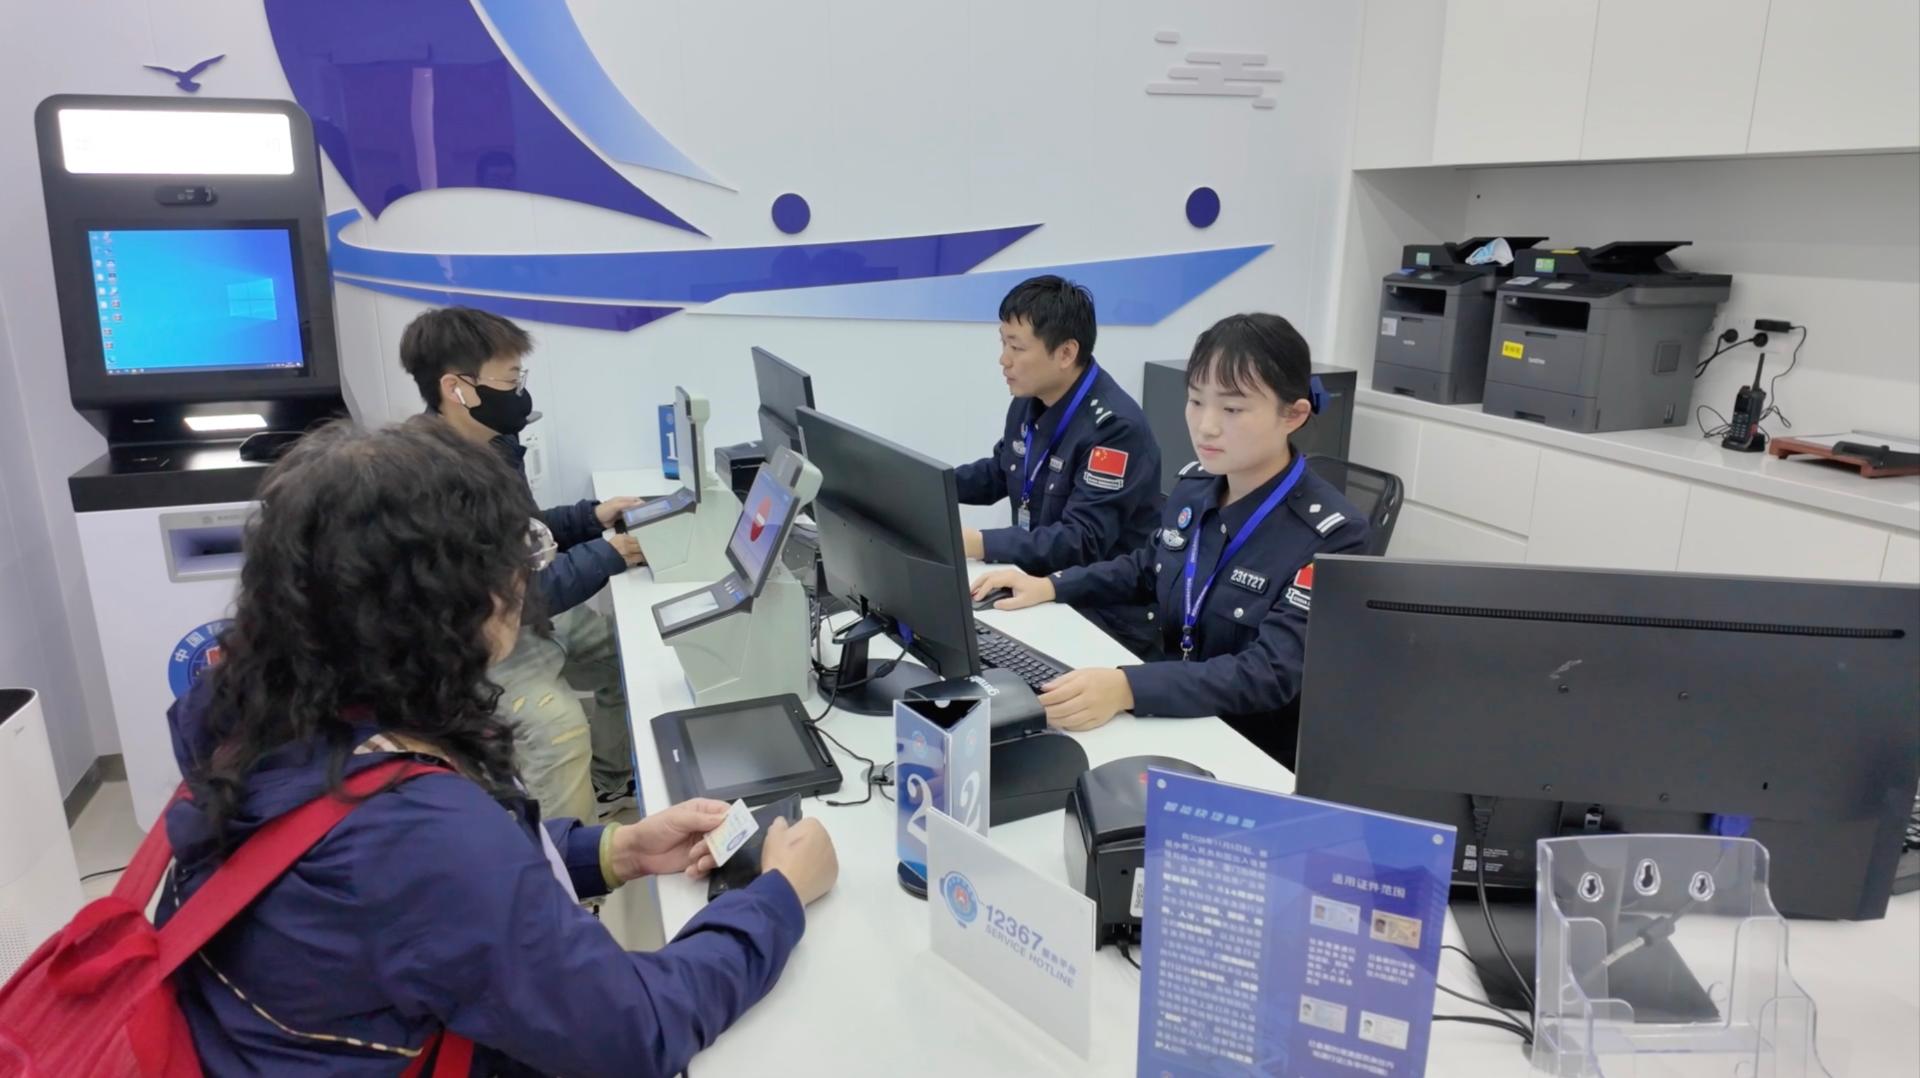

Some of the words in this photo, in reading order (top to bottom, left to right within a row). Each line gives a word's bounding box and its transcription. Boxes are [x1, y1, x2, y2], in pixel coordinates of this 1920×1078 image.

[666, 431, 679, 460] 1
[1230, 569, 1266, 590] 231727
[907, 773, 932, 845] 2
[986, 904, 1043, 951] 12367
[985, 924, 1026, 957] SERVICE
[1028, 952, 1075, 989] HOTLINE
